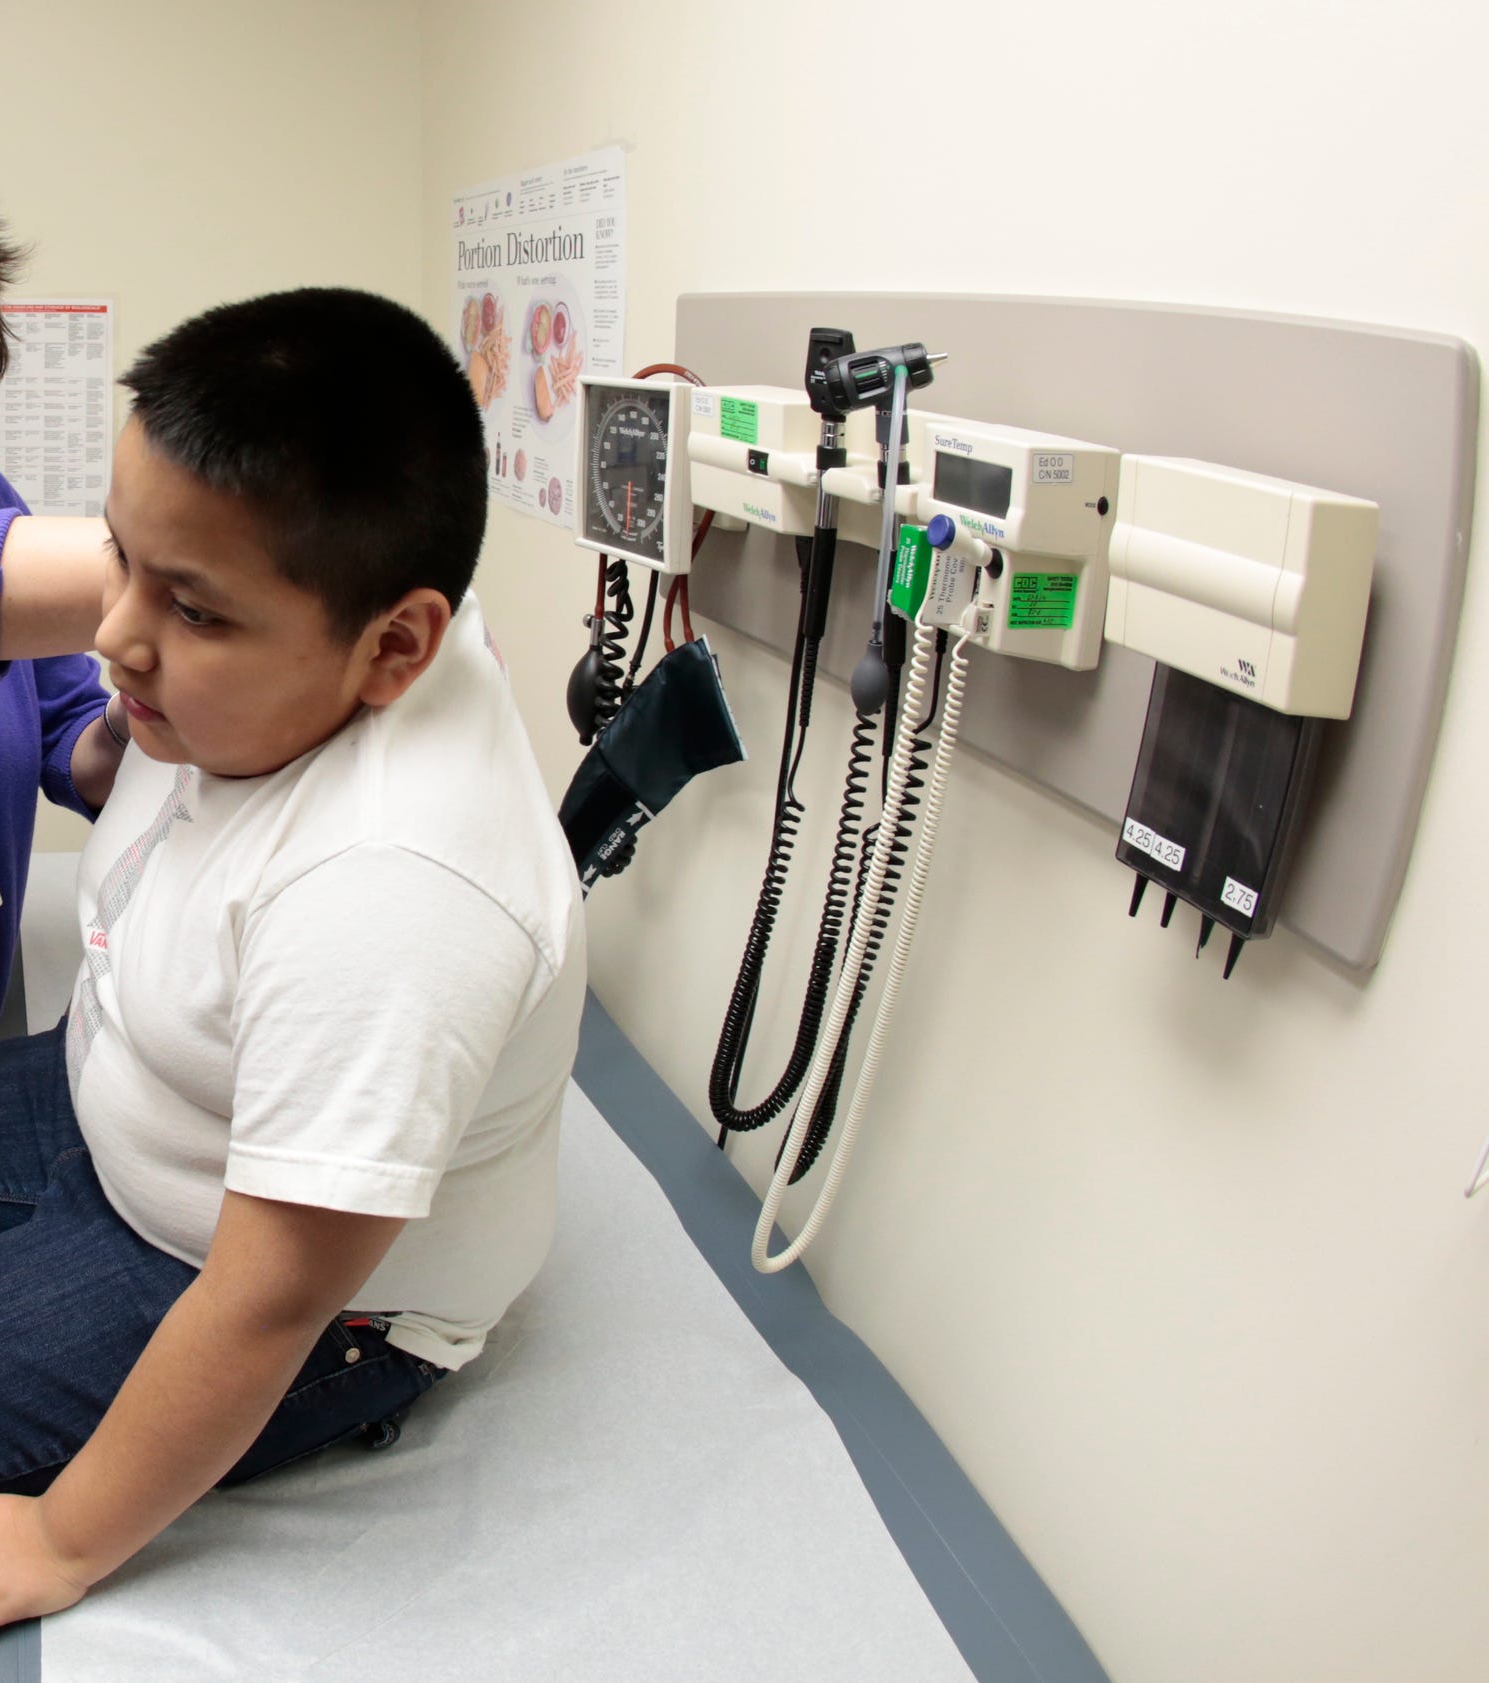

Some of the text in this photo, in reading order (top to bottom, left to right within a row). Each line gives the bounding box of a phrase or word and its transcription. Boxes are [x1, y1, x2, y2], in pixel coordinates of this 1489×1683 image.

[457, 237, 502, 271] Portion
[506, 225, 585, 266] Distortion
[934, 434, 973, 455] SureTemp
[946, 577, 955, 603] Probe
[599, 830, 626, 861] RANGE
[1126, 824, 1181, 865] 4.25 4.25
[1224, 883, 1254, 911] 2.75
